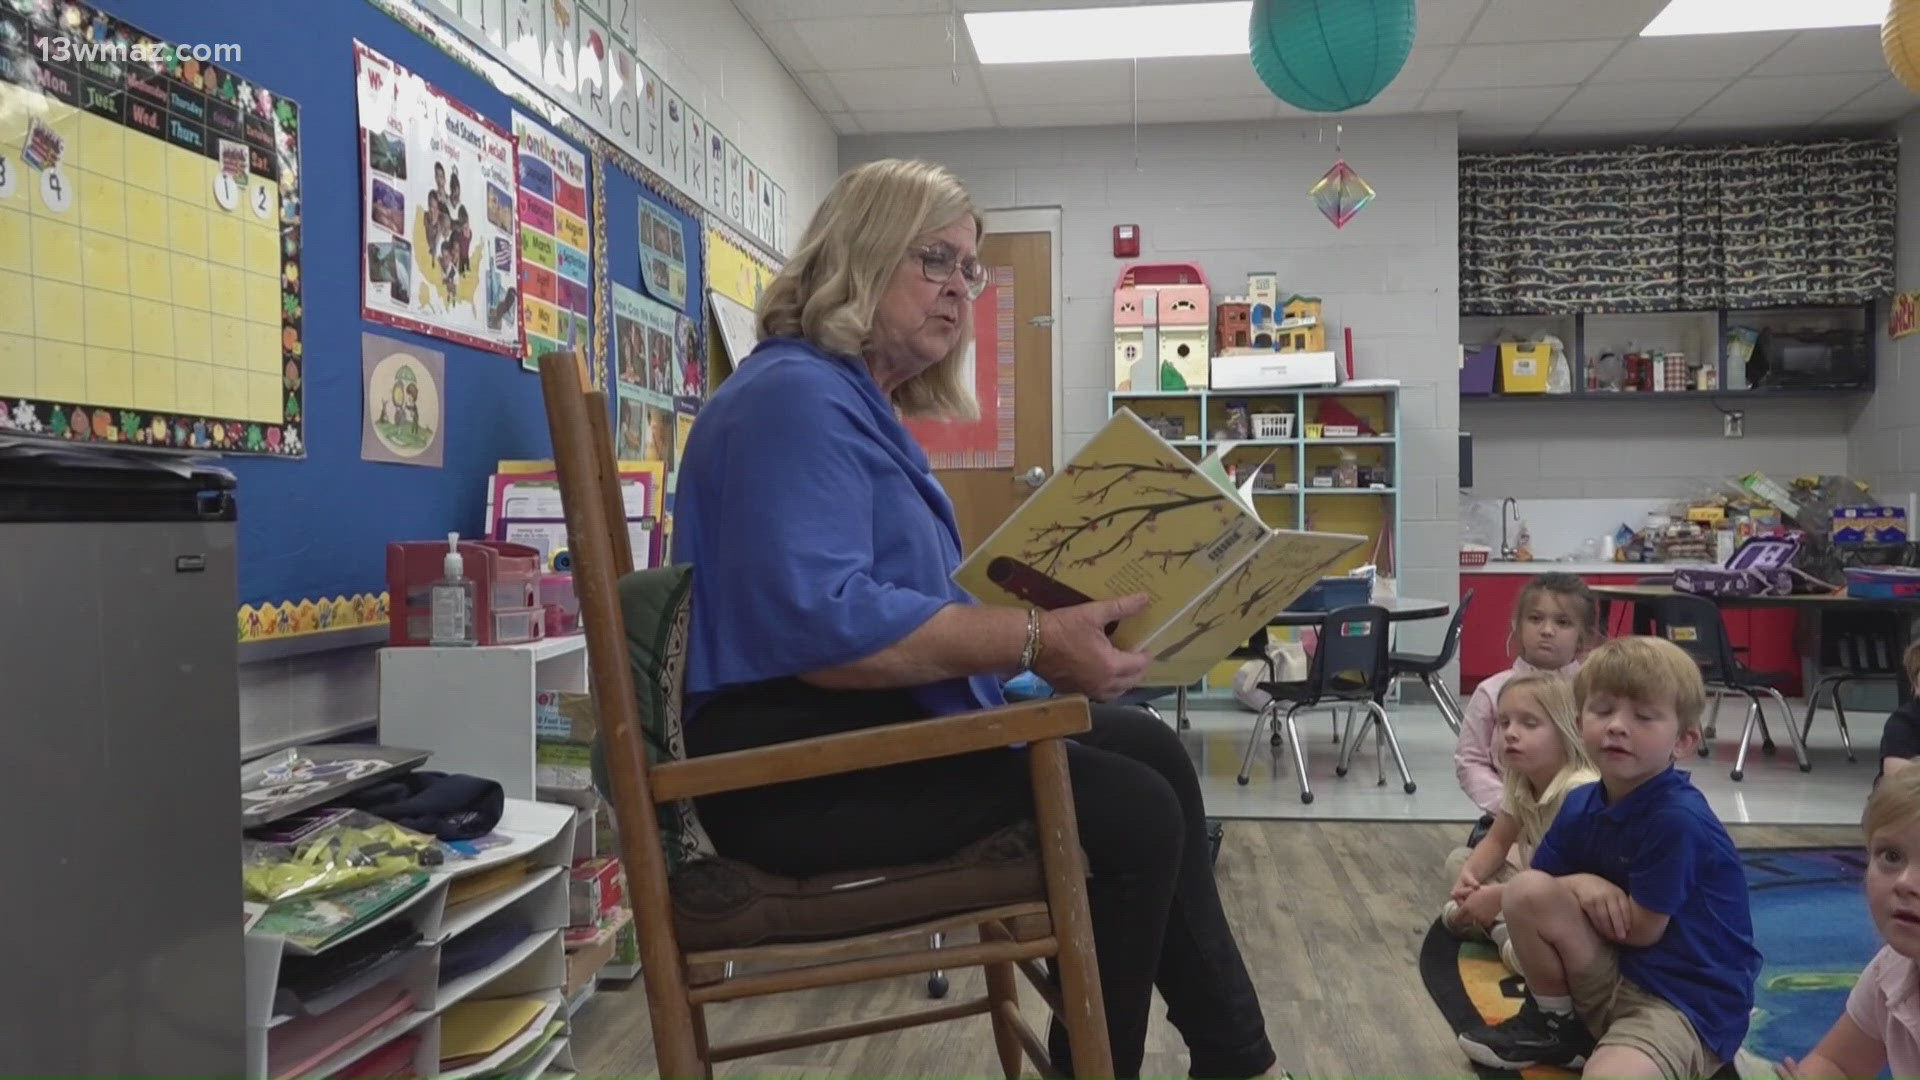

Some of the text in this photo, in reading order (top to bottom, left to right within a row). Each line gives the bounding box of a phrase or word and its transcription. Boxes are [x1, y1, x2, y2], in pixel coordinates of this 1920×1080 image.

[132, 104, 160, 131] Wed.
[619, 101, 631, 137] C
[170, 119, 203, 147] Thurs.
[645, 122, 657, 155] J
[669, 140, 680, 173] Y
[693, 159, 701, 188] K
[257, 186, 268, 212] 2
[713, 175, 721, 208] E
[731, 191, 740, 220] G
